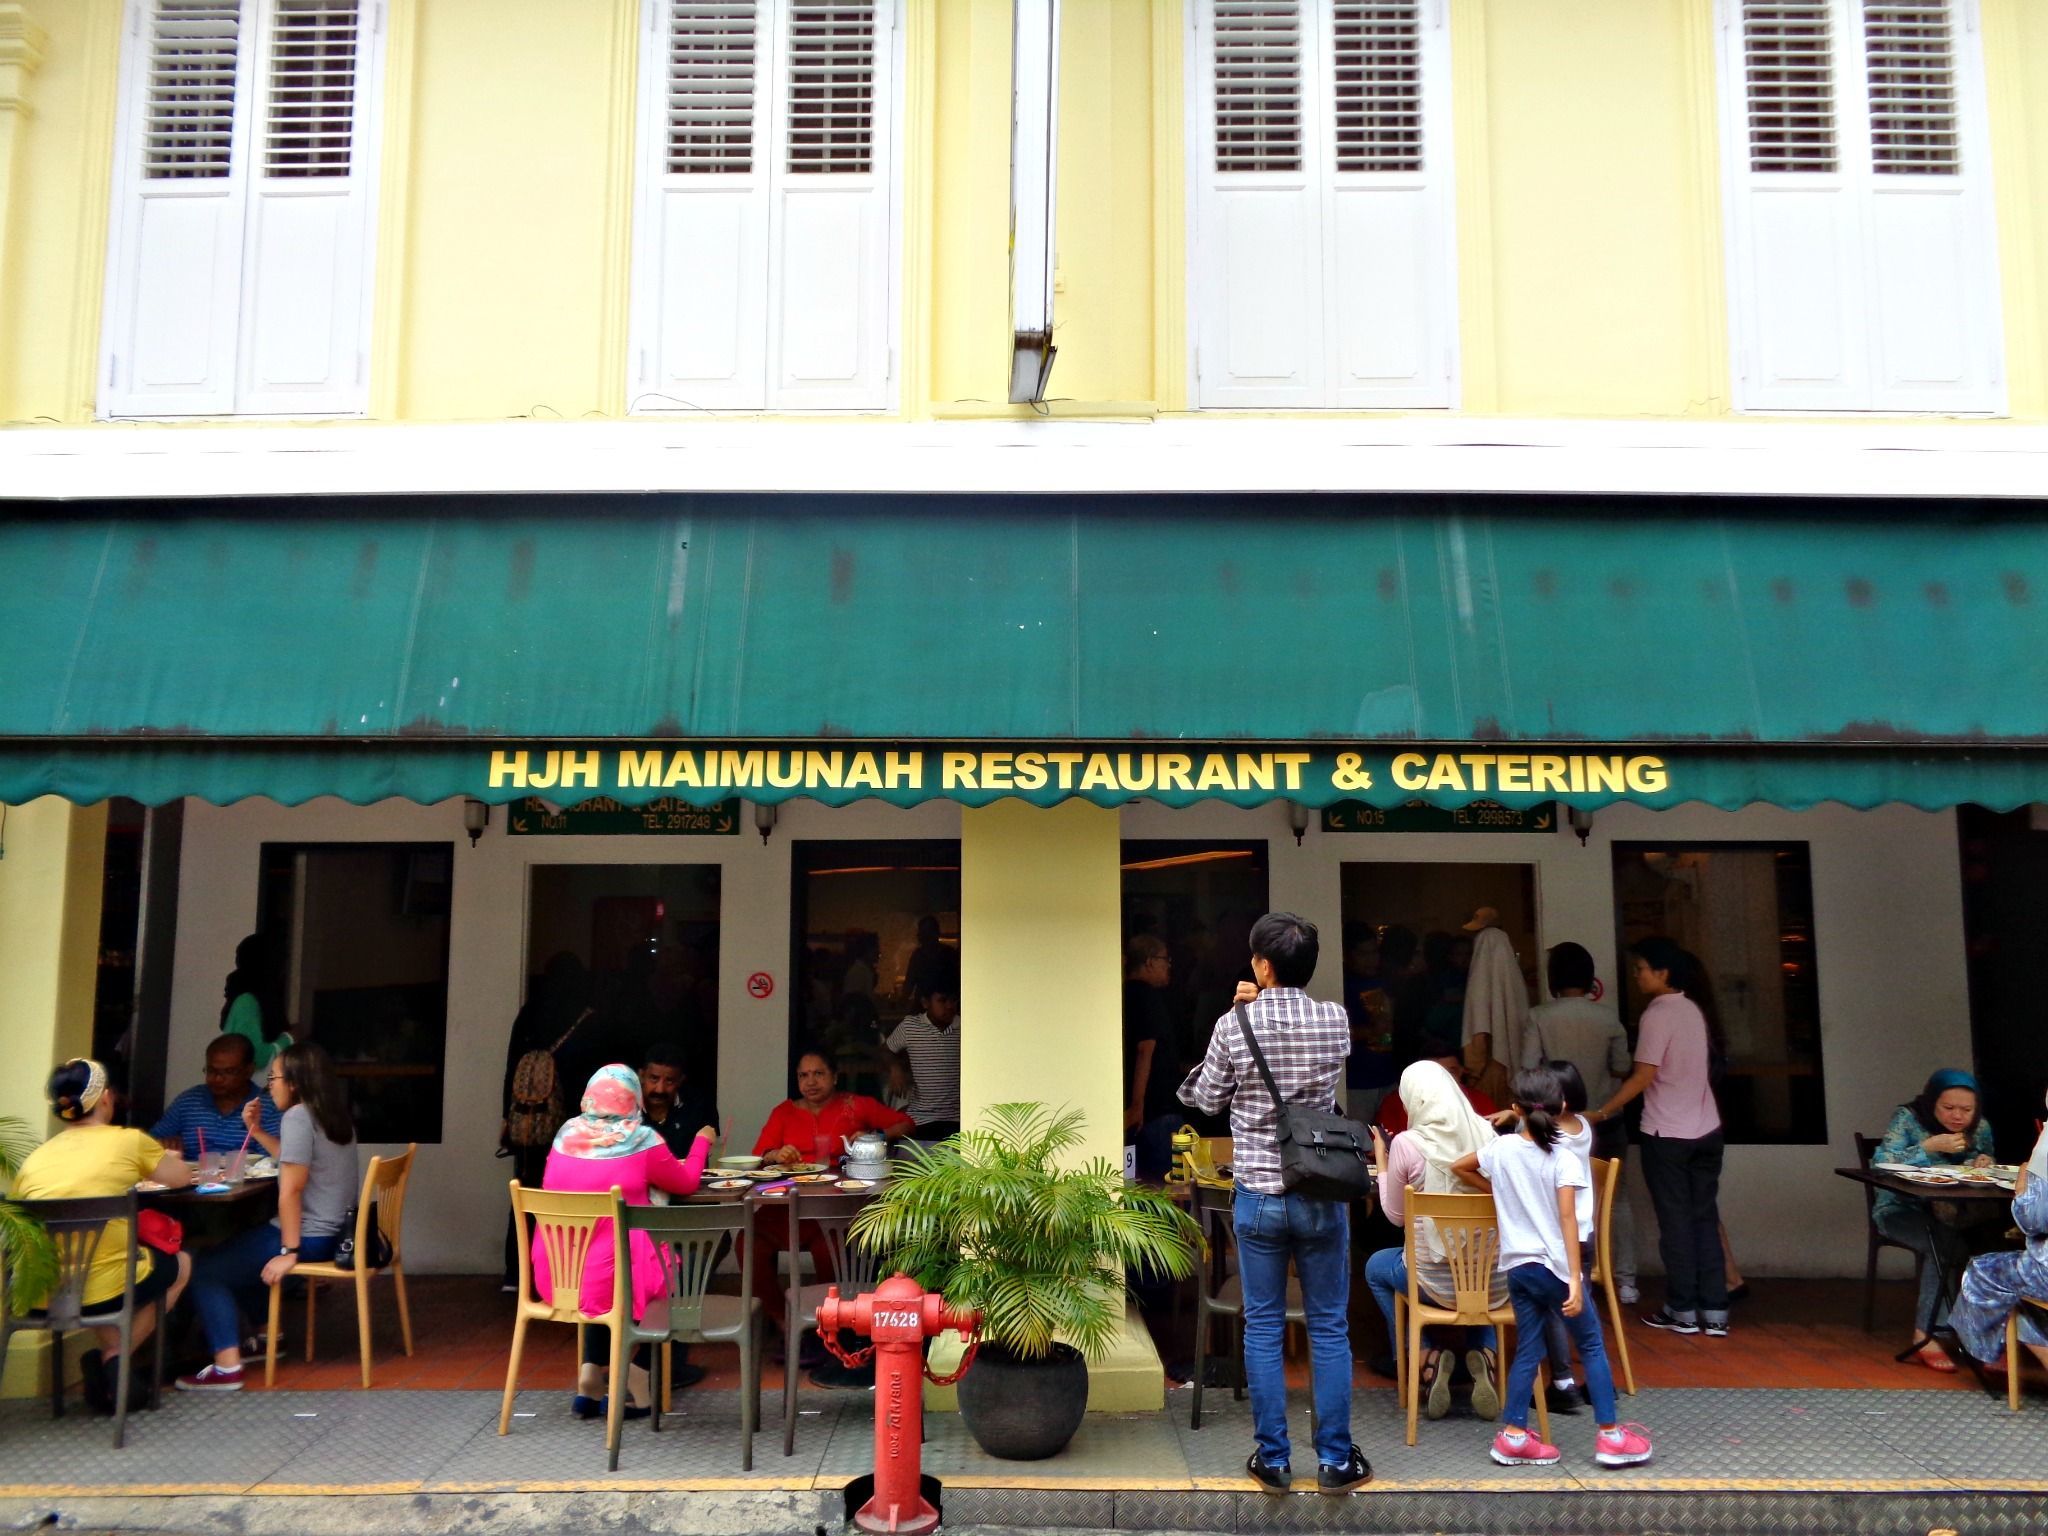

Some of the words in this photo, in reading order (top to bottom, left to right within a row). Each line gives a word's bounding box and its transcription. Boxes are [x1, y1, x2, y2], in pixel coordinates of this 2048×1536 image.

[488, 750, 599, 788] HJH
[618, 750, 922, 789] MAIMUNAH
[942, 752, 1310, 790] RESTAURANT
[1331, 752, 1373, 790] &
[1391, 753, 1668, 793] CATERING
[667, 814, 711, 829] 2917248
[1126, 1152, 1133, 1168] 9
[874, 1312, 918, 1328] 17628
